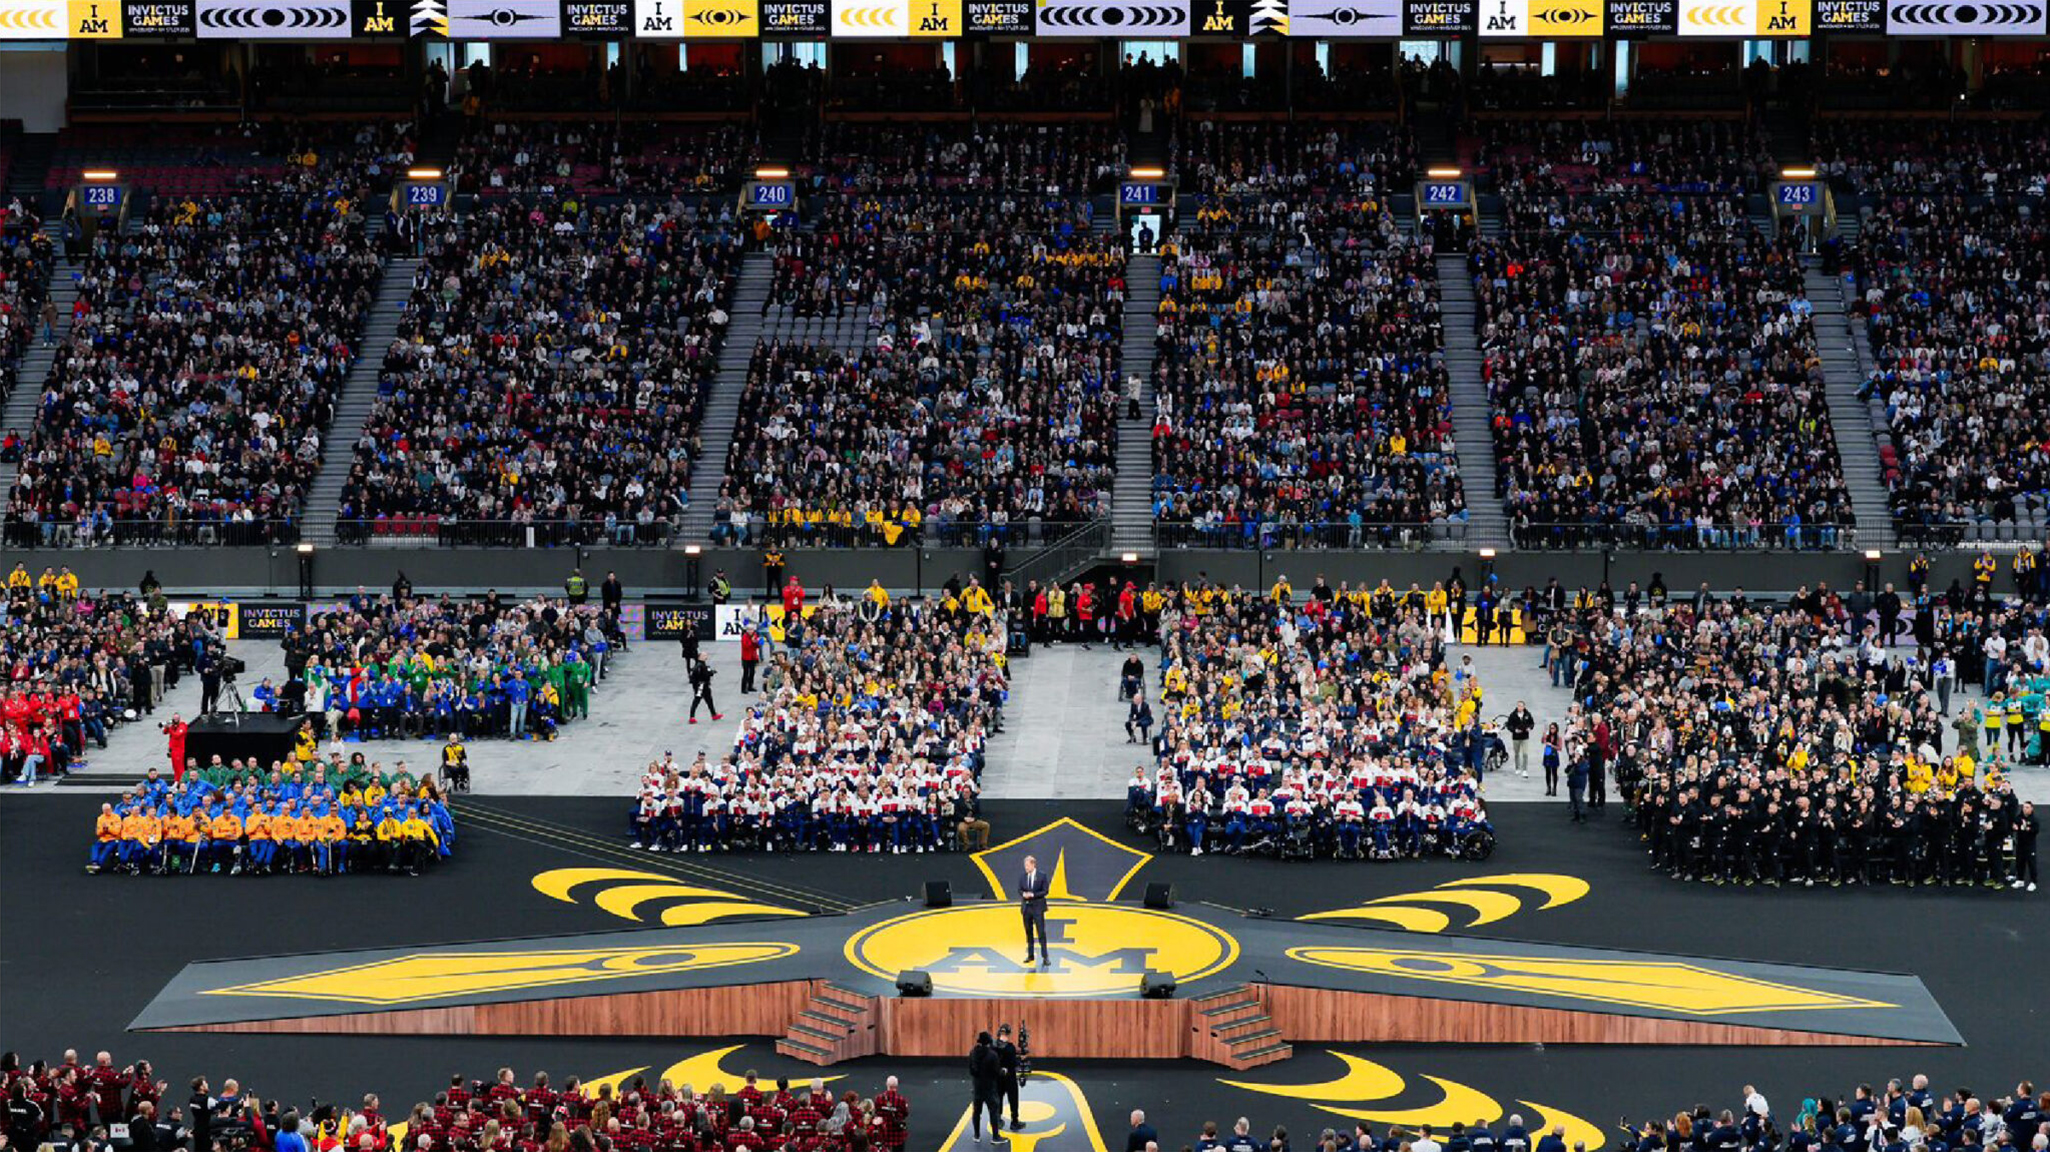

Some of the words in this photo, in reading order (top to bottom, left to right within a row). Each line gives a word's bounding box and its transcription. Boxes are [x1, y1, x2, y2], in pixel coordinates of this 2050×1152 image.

[90, 5, 97, 17] I
[128, 5, 188, 15] INVICTUS
[376, 2, 383, 16] I
[567, 5, 627, 14] INVICTUS
[656, 2, 662, 15] I
[764, 4, 824, 14] INVICTUS
[931, 3, 938, 15] I
[969, 4, 1029, 13] INVICTUS
[1216, 0, 1223, 15] I
[1410, 3, 1470, 13] INVICTUS
[1500, 1, 1506, 14] I
[1610, 2, 1671, 12] INVICTUS
[1780, 1, 1787, 14] I
[1818, 1, 1879, 12] INVICTUS
[133, 16, 179, 26] GAMES
[572, 15, 618, 25] GAMES
[769, 14, 814, 25] GAMES
[972, 14, 1018, 24] GAMES
[1203, 15, 1233, 31] AM
[1415, 13, 1460, 24] GAMES
[1487, 15, 1516, 30] AM
[1615, 13, 1661, 23] GAMES
[1767, 16, 1796, 29] AM
[1822, 12, 1869, 22] GAMES
[80, 20, 108, 33] AM
[364, 17, 394, 32] AM
[643, 17, 672, 31] AM
[919, 17, 948, 31] AM
[89, 187, 115, 203] 238
[411, 186, 437, 202] 239
[759, 186, 786, 202] 240
[1125, 186, 1149, 202] 241
[1430, 185, 1456, 201] 242
[1784, 186, 1810, 202] 243
[244, 609, 300, 618] INVICTUS
[652, 610, 708, 620] INVICTUS
[734, 608, 741, 621] I
[248, 618, 291, 628] GAMES
[913, 947, 1158, 973] AM
